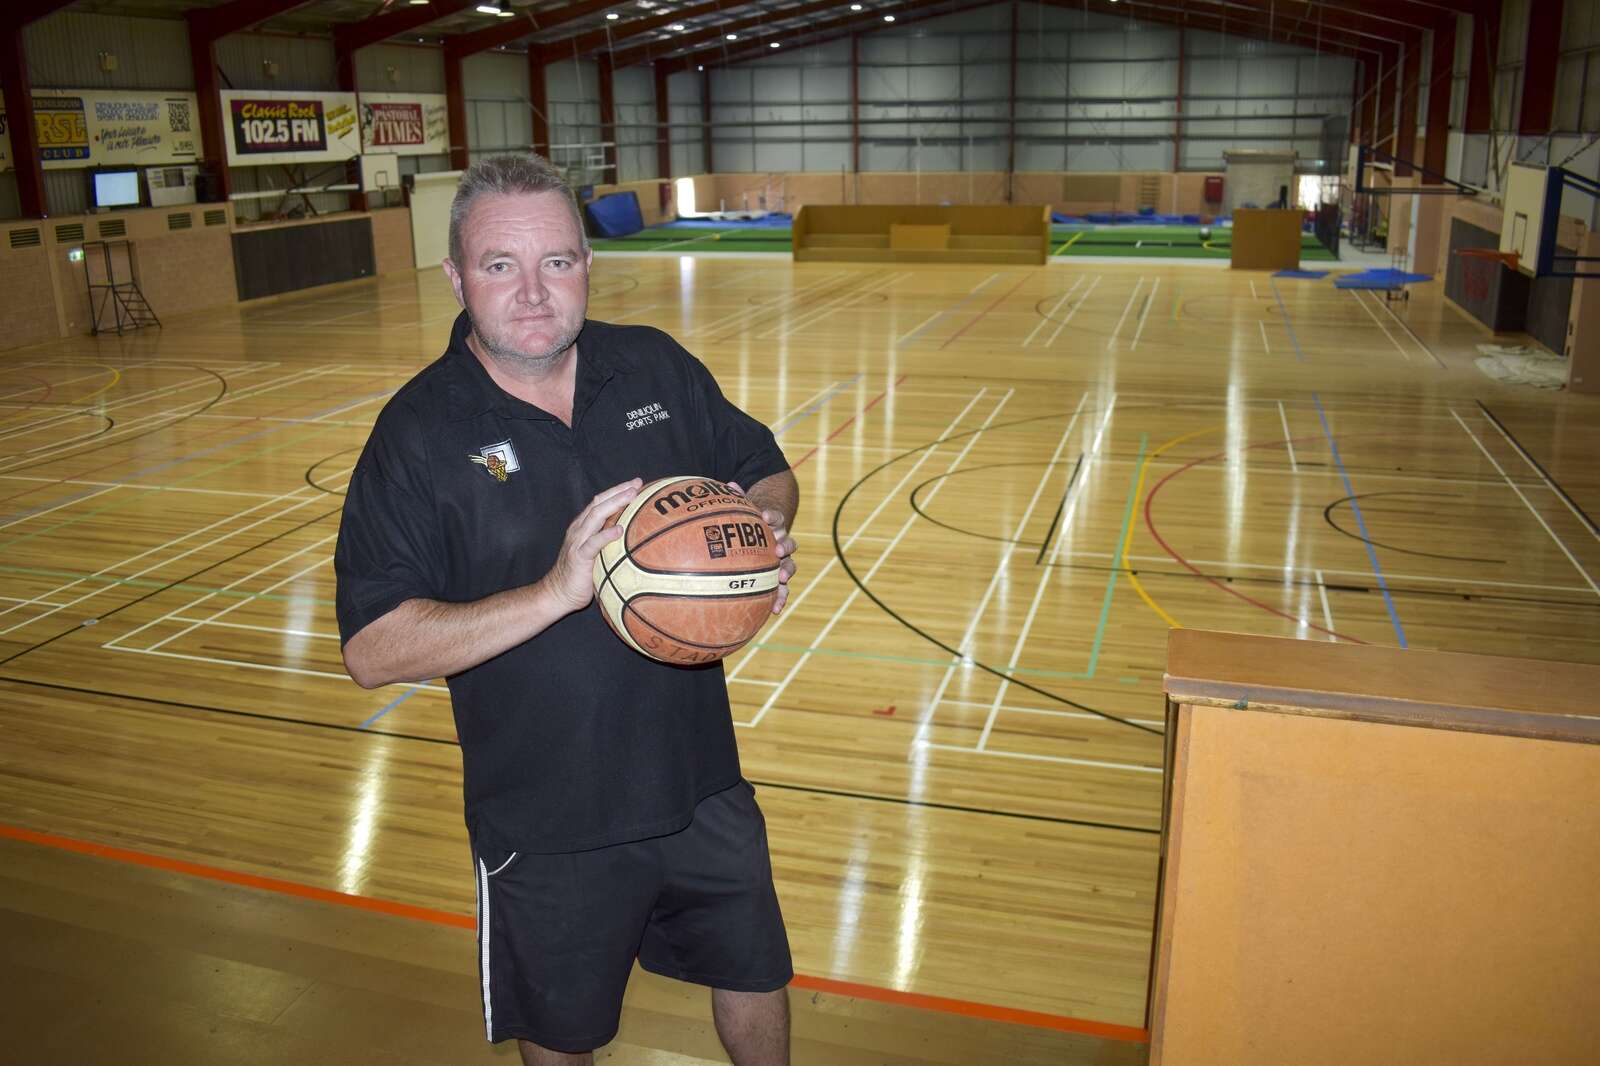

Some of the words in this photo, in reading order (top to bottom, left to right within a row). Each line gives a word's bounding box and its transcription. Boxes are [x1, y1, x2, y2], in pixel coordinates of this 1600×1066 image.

[241, 103, 286, 119] Classic
[288, 102, 316, 118] Rock
[34, 113, 88, 143] RSL
[241, 119, 290, 144] 102.5
[292, 119, 320, 143] FM
[375, 120, 422, 144] TIMES
[625, 416, 653, 431] SPORTS
[653, 410, 671, 422] PARK
[654, 480, 745, 515] molte
[722, 522, 768, 548] FIBA
[729, 578, 756, 590] GF7
